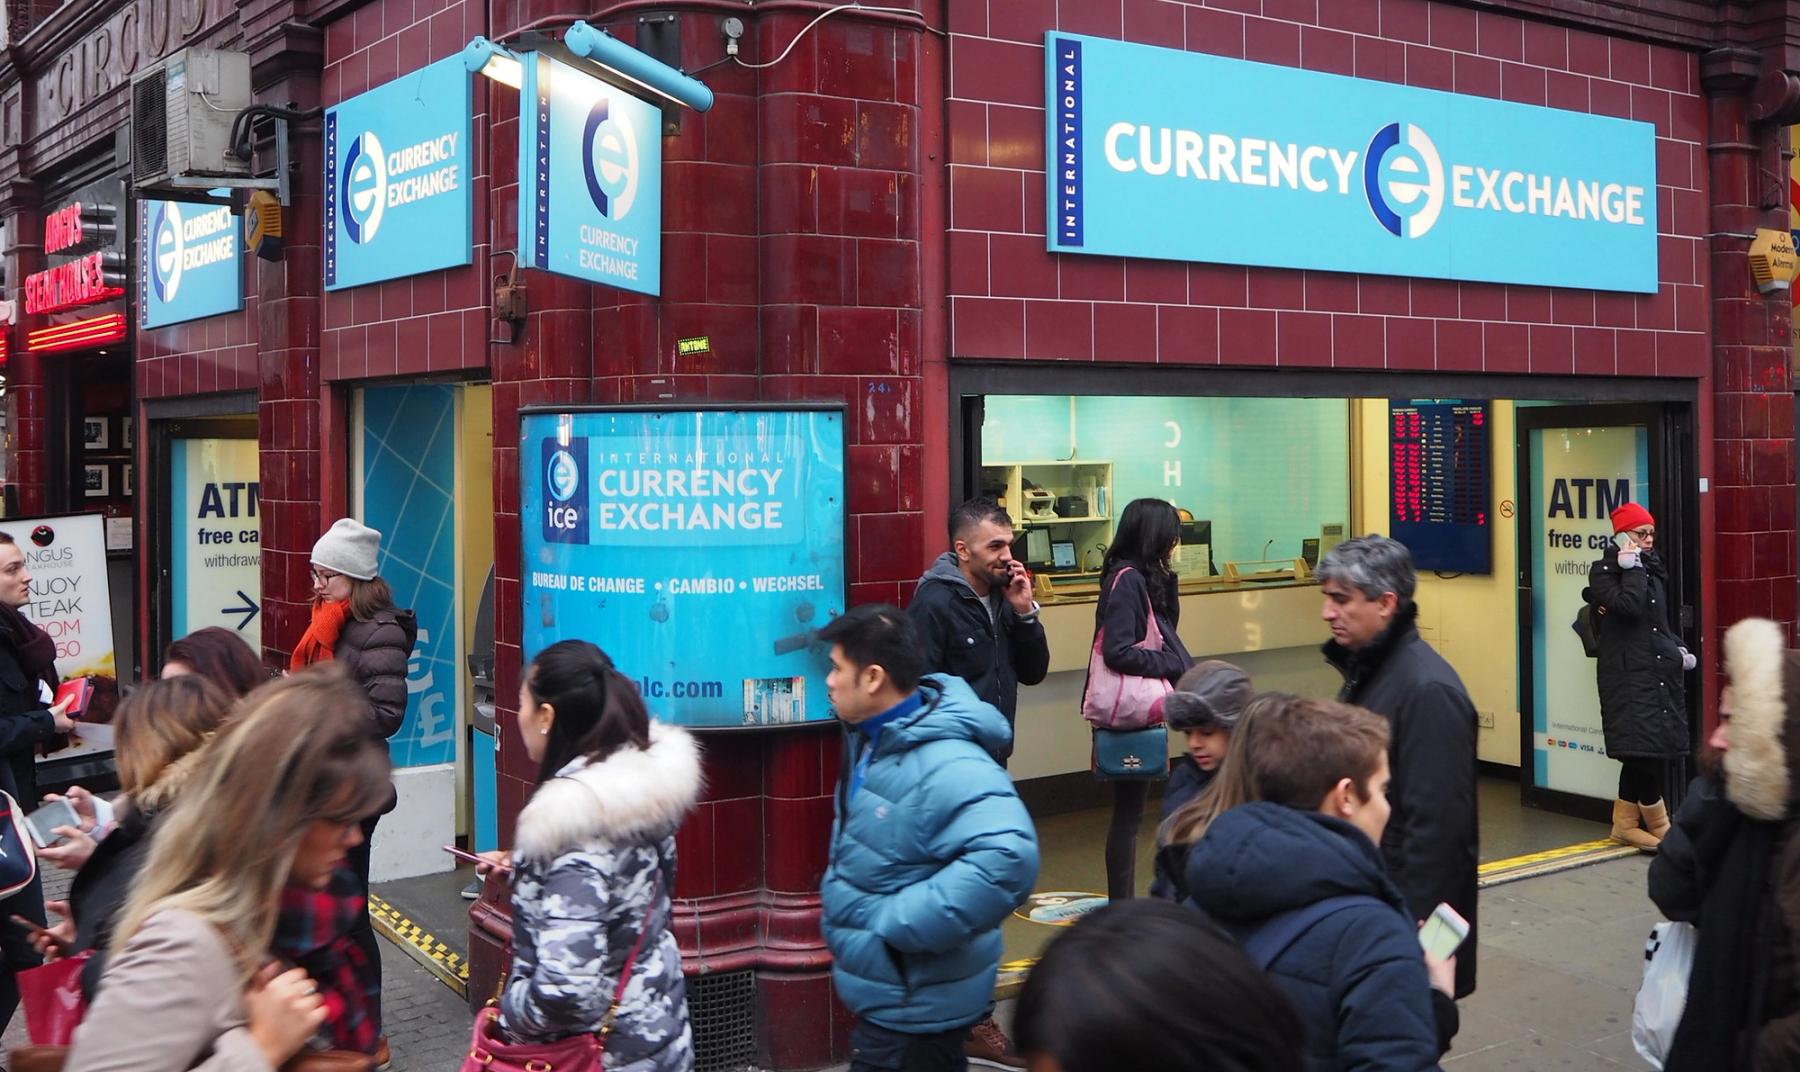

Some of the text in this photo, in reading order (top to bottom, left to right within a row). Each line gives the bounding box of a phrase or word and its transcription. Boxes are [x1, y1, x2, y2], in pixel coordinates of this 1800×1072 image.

[387, 131, 459, 177] CURRENCY
[1064, 49, 1076, 238] INTERNATIONAL
[387, 164, 459, 209] EXCHANGE
[539, 96, 548, 257] INTERNATION
[1104, 122, 1645, 226] CURRENCY EXCHANGE
[44, 201, 83, 255] ANGUS
[183, 206, 232, 243] CURRENCY
[183, 235, 234, 271] EXCHANGE
[579, 223, 639, 257] CURRENCY
[578, 248, 639, 280] EXCHANGE
[600, 451, 784, 466] INTERNATIONAL
[599, 468, 783, 498] CURRENCY
[1548, 478, 1630, 520] ATM
[548, 501, 578, 529] ice
[600, 501, 783, 530] EXCHANGE
[198, 527, 260, 545] free ca
[1548, 528, 1582, 549] free
[23, 547, 73, 563] NGUS
[1554, 560, 1592, 576] withdr
[27, 576, 82, 597] NJOY
[532, 572, 824, 594] BUREAU DE CHANGE CAMBIO WECHSEL
[22, 597, 83, 619] TEAK
[1580, 744, 1594, 752] VISA
